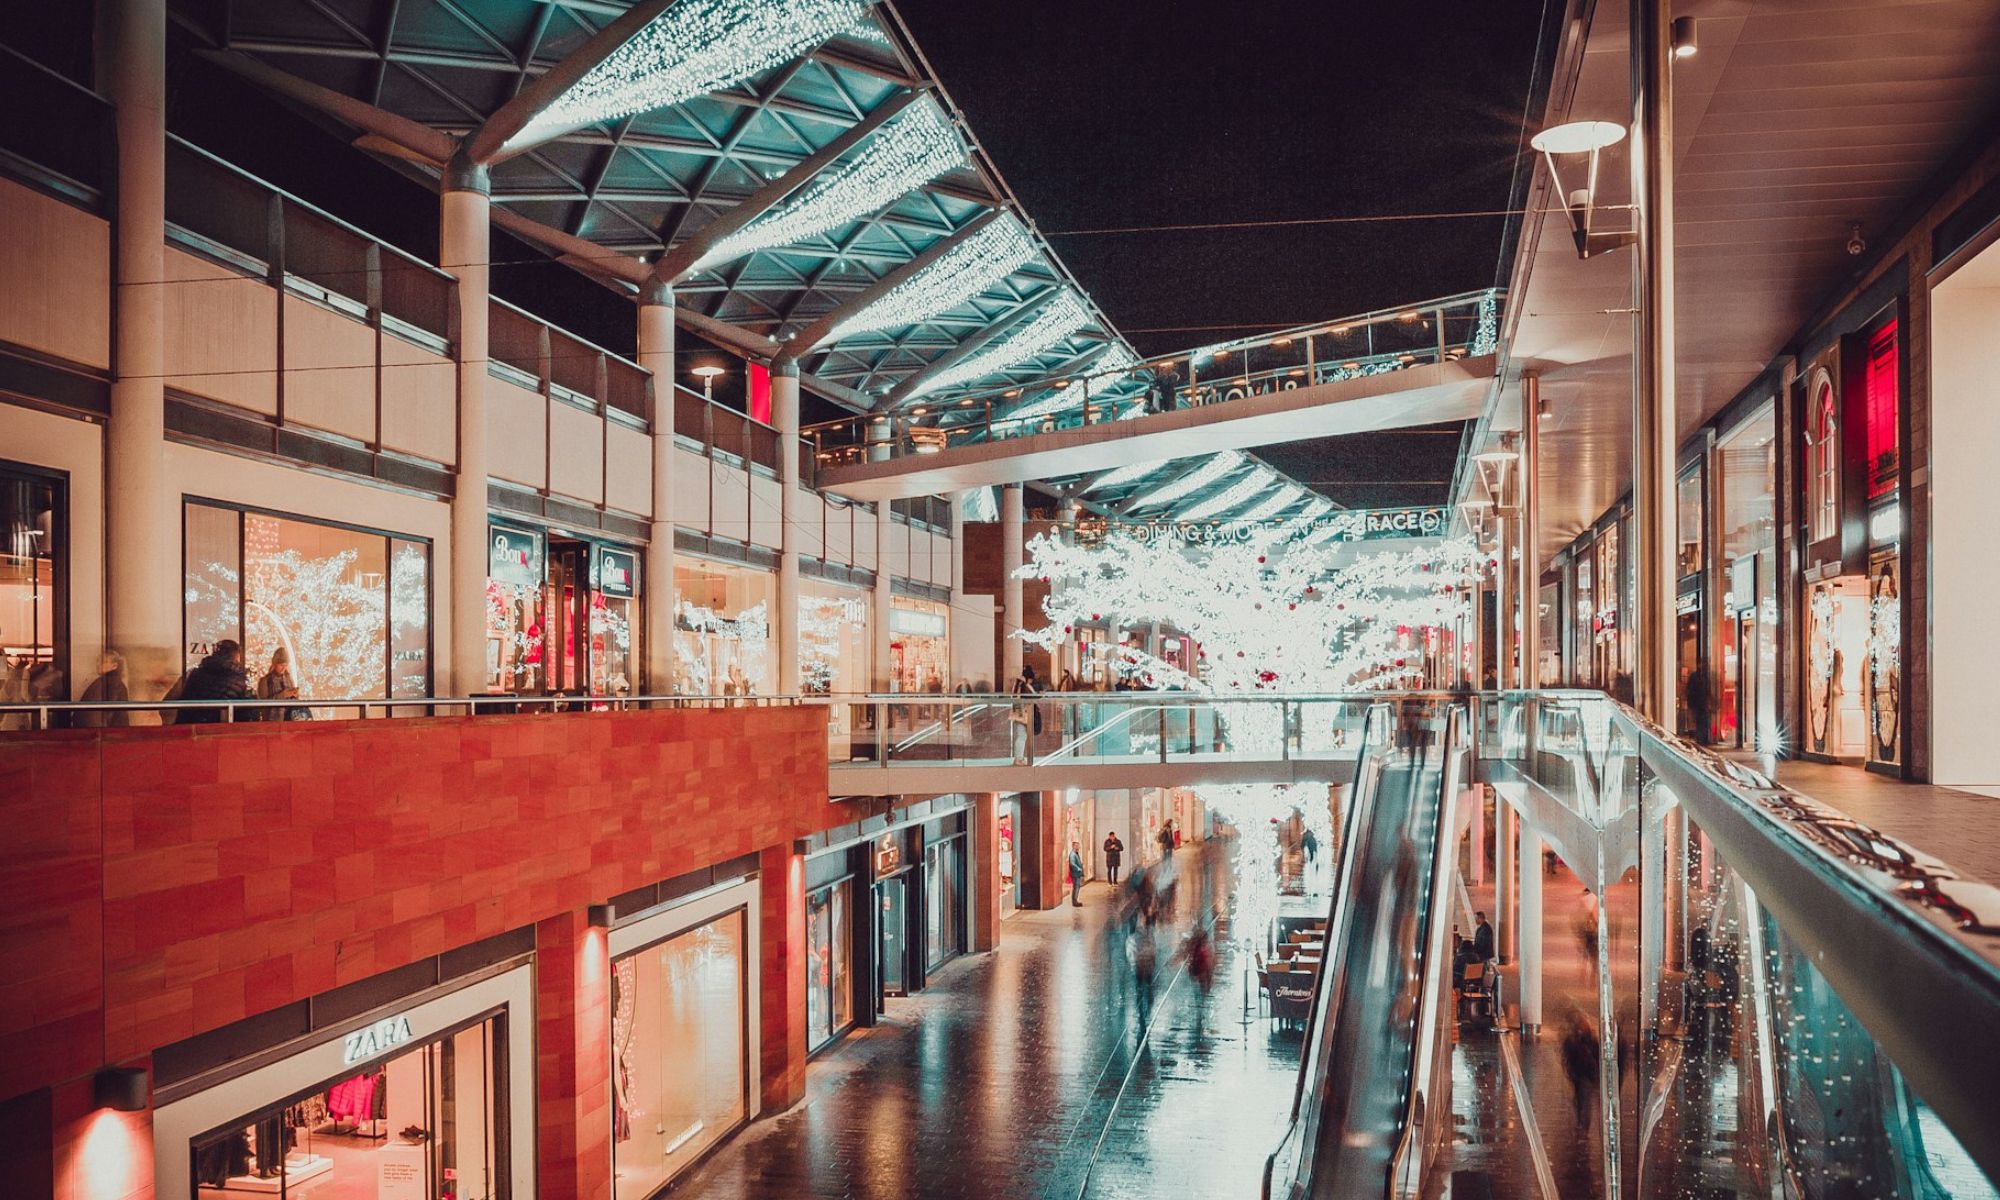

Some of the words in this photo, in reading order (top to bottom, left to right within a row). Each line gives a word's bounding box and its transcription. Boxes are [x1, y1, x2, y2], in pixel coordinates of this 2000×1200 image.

[1138, 524, 1200, 541] DINING
[1204, 524, 1217, 541] &
[345, 1016, 412, 1064] ZARA
